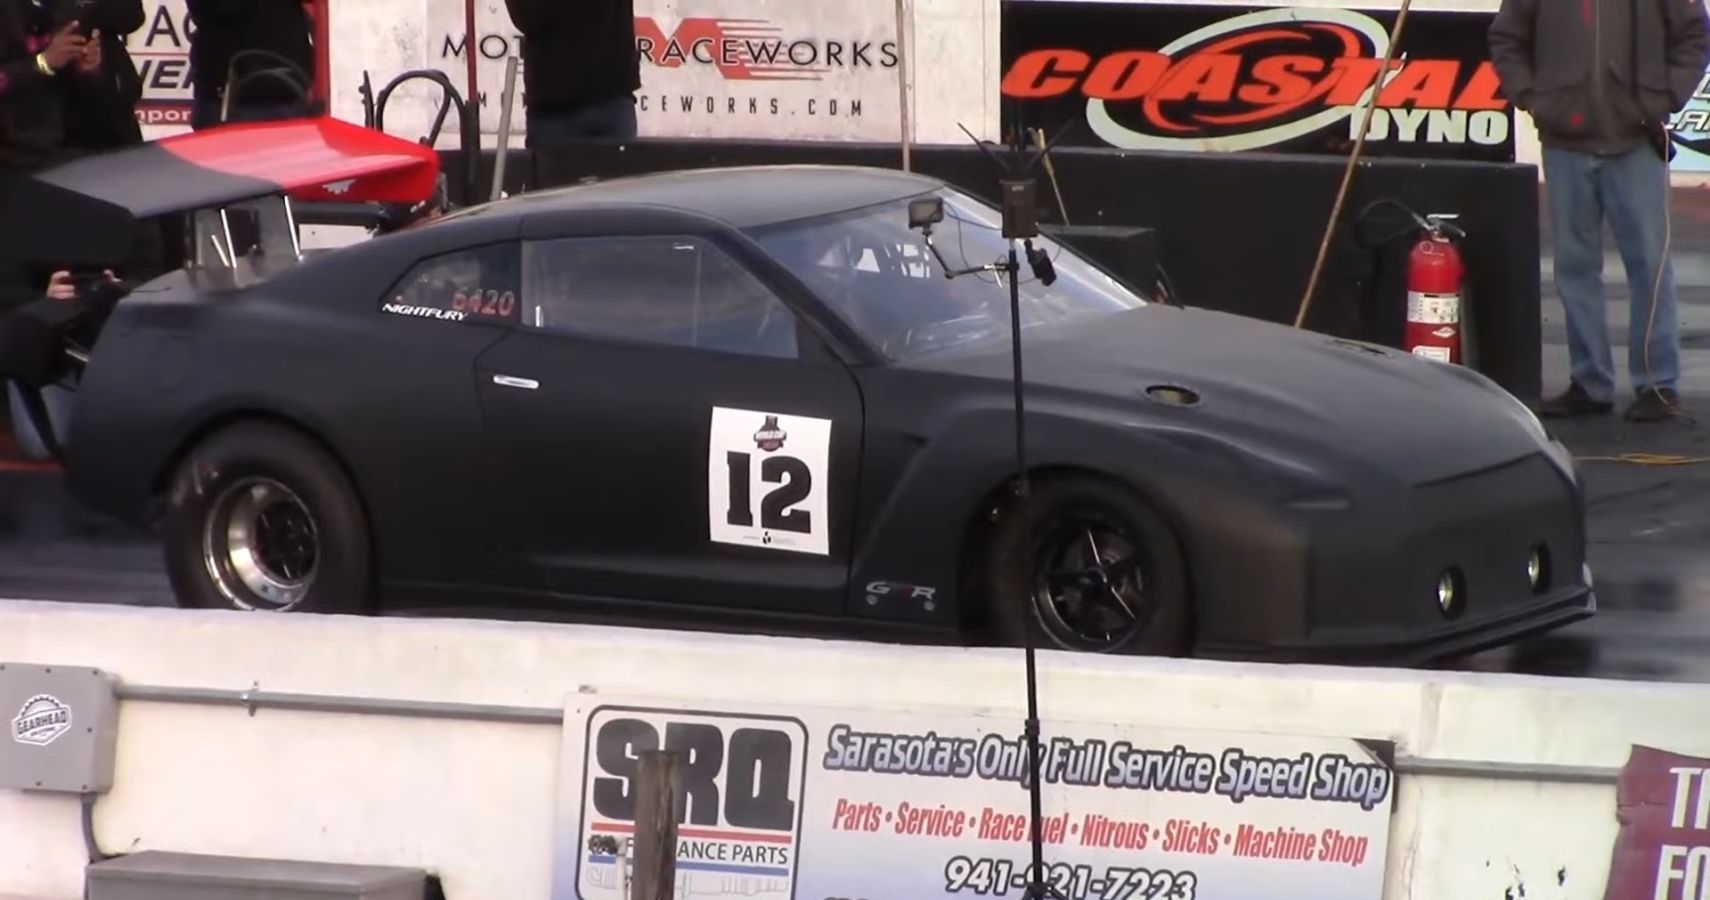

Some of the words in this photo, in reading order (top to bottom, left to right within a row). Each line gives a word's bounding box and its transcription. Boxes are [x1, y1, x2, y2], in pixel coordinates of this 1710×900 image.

[637, 37, 898, 68] RACEWORKS
[1001, 48, 1508, 111] COASTAL
[1350, 104, 1509, 145] DYNO
[382, 303, 469, 321] NIGHTFURY
[727, 450, 812, 534] 12
[17, 710, 68, 735] GEARHEAD
[593, 718, 795, 831] SRQ
[823, 724, 976, 778] Sarasota's
[1046, 736, 1106, 787] Full
[1104, 741, 1216, 794] Service
[1215, 748, 1313, 803] Speed
[1311, 754, 1390, 811] Shop
[732, 845, 788, 865] PARTS
[832, 798, 883, 833] Parts
[895, 801, 966, 838] Service
[977, 807, 1027, 842] Race
[1080, 813, 1150, 850] Nitrous
[1162, 818, 1221, 855] Slicks
[1233, 823, 1317, 862] Machine
[1318, 828, 1369, 867] Shop
